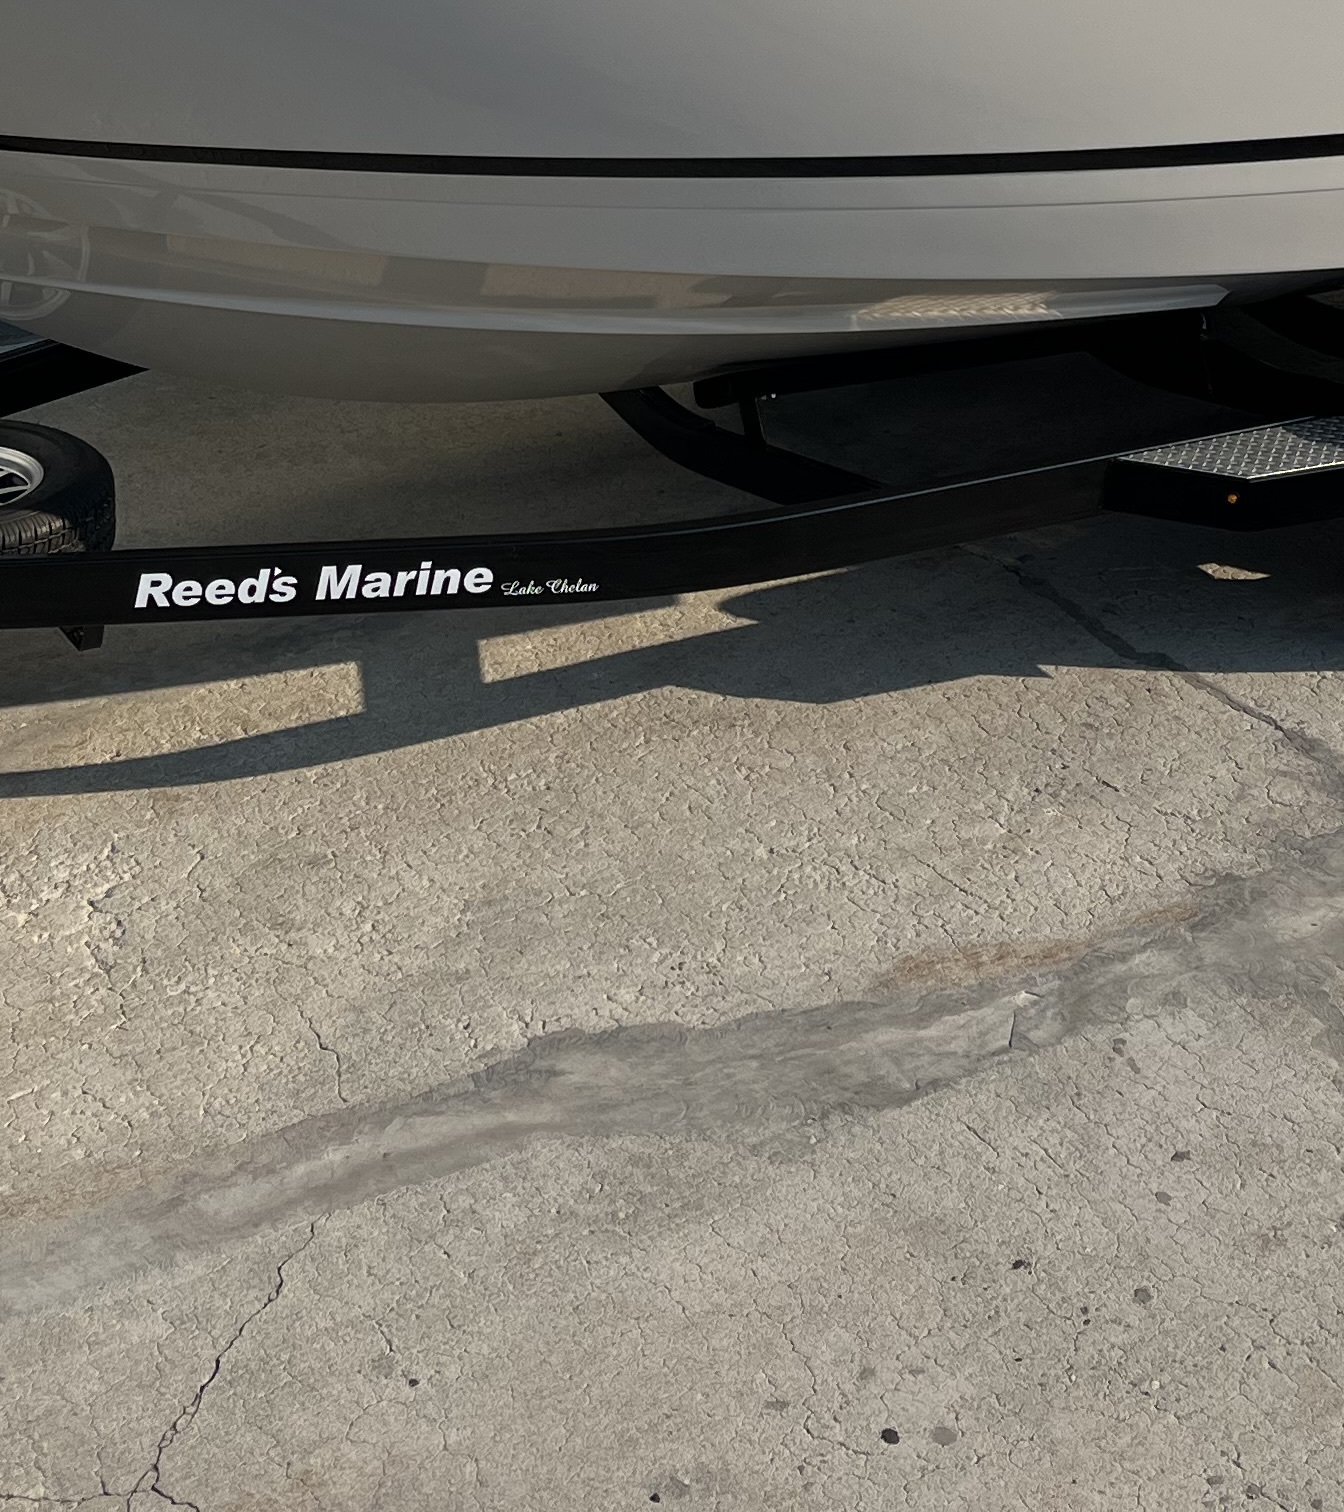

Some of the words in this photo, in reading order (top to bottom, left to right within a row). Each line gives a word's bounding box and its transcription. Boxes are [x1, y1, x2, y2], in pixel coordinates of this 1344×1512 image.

[134, 566, 299, 609] Reed's
[315, 560, 494, 601] Marine
[500, 580, 545, 596] Lake
[545, 577, 600, 594] Chelan
